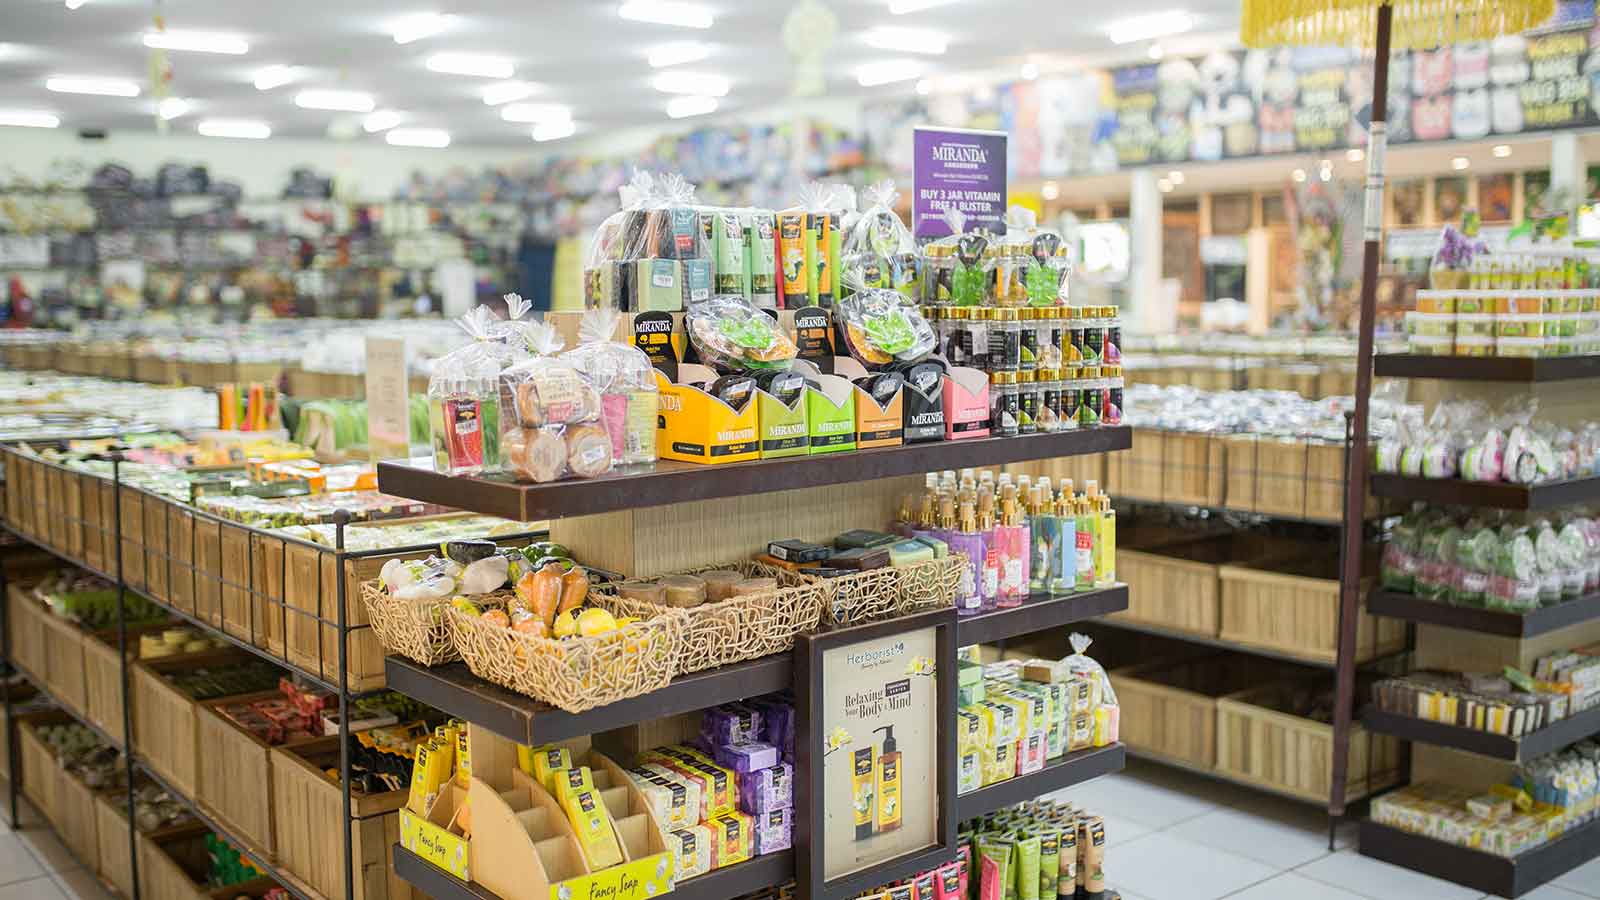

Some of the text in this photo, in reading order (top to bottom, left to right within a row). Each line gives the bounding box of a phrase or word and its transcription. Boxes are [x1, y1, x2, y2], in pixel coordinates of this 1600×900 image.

[932, 146, 986, 163] MIRANDA
[921, 189, 1000, 202] BUY 3 JAR VITAMIN
[930, 200, 950, 210] FREE
[960, 202, 992, 212] BLISTER
[635, 323, 671, 332] MIRANDA
[796, 319, 827, 328] MIRANDA
[847, 648, 896, 664] Herborist
[845, 689, 883, 707] Relaxing
[859, 701, 883, 719] Body
[889, 694, 911, 710] Mind
[589, 872, 639, 900] Fancy Soap
